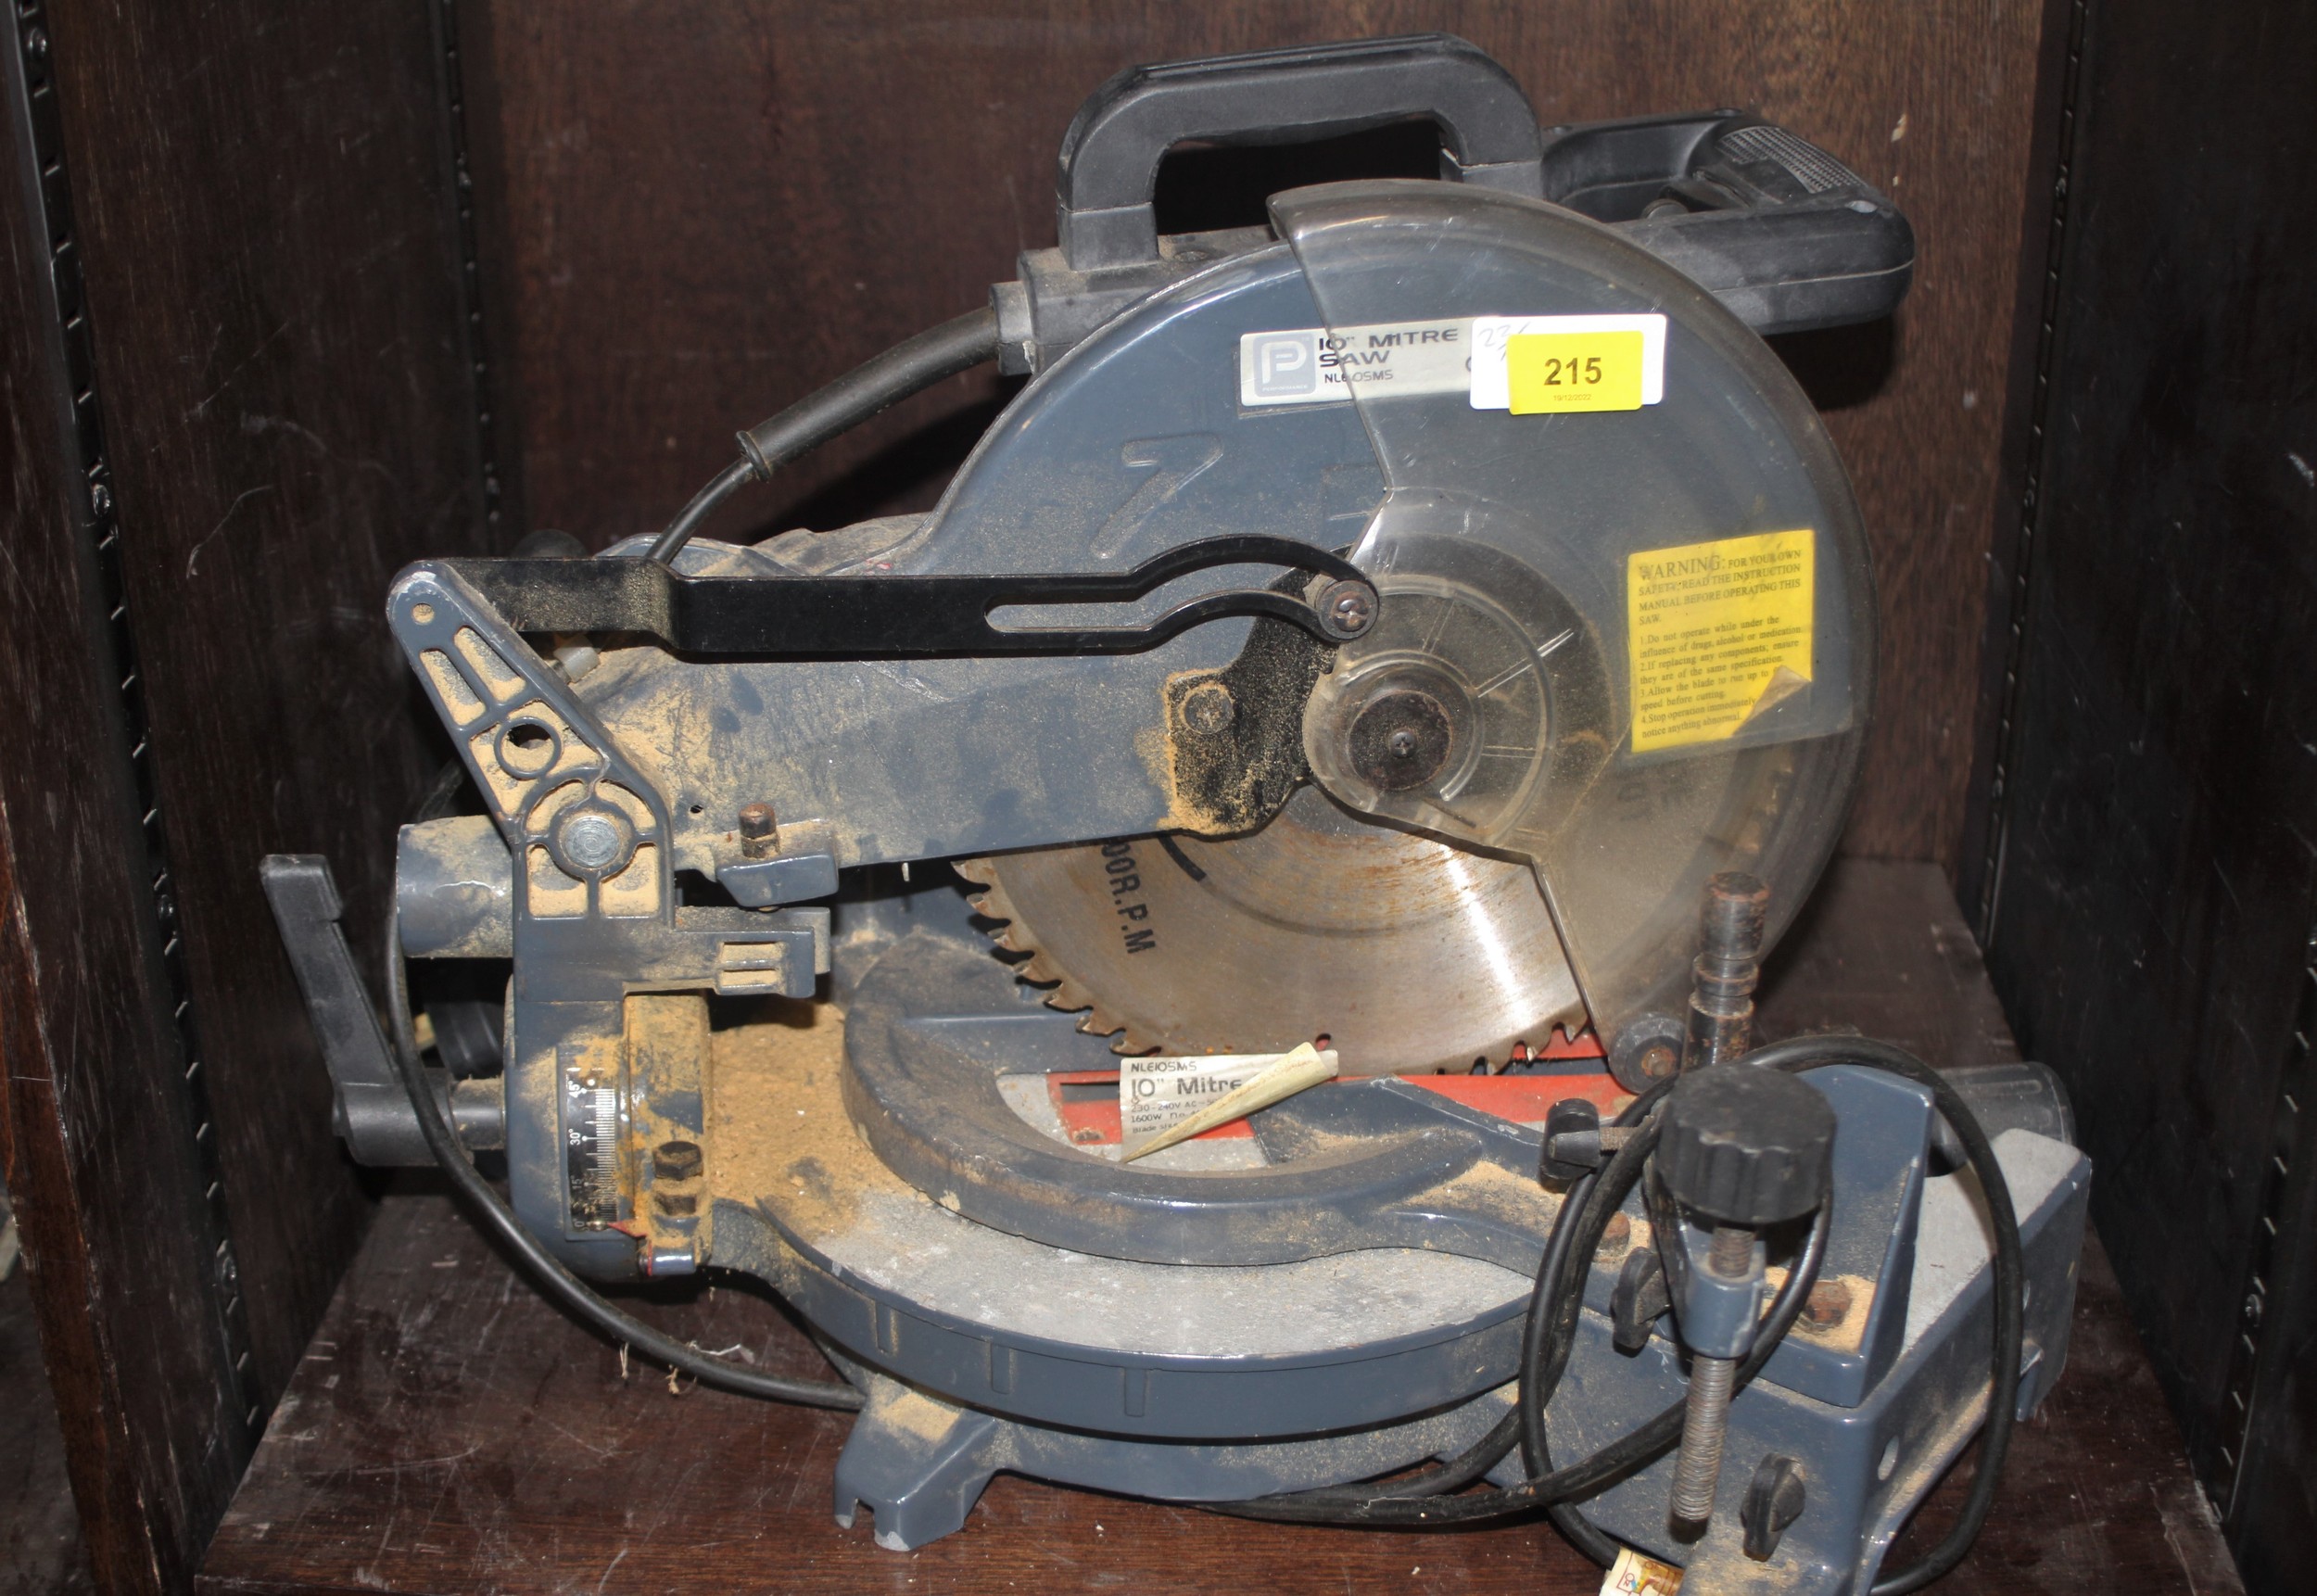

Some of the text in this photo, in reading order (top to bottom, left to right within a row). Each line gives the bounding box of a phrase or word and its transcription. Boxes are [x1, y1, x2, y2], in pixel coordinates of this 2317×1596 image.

[1369, 327, 1459, 348] MITRE
[1319, 349, 1390, 368] SAW
[1543, 356, 1602, 386] 215
[1552, 393, 1592, 402] 19/12/2022
[1639, 550, 1801, 581] WARNING: FOR YOUR OWN
[1682, 577, 1710, 590] READ
[1713, 573, 1731, 584] THE
[1733, 564, 1801, 580] INSTRUCTION
[1639, 578, 1801, 612] MANUAL BEFORE OPERATING THIS
[1639, 613, 1662, 626] SAW.
[1664, 632, 1677, 641] not
[1680, 627, 1711, 640] operate
[1715, 622, 1736, 633] while
[1741, 617, 1763, 629] under
[1767, 615, 1779, 626] the
[1640, 645, 1676, 659] influence
[1678, 642, 1688, 652] of
[1716, 633, 1744, 646] alcohol
[1658, 653, 1696, 669] replacing
[1700, 652, 1715, 663] any
[1772, 640, 1800, 651] ensure
[1640, 676, 1657, 686] they
[1661, 673, 1674, 681] are
[1678, 668, 1687, 678] of
[1690, 665, 1703, 677] the
[1706, 664, 1727, 674] same
[1676, 682, 1690, 692] the
[1692, 678, 1715, 690] blade
[1718, 677, 1727, 685] to
[1730, 675, 1743, 683] run
[1747, 672, 1757, 682] up
[1761, 669, 1769, 678] to
[1640, 701, 1664, 712] speed
[1666, 694, 1692, 706] before
[1668, 705, 1705, 719] operation
[1707, 698, 1757, 713] immediately
[1641, 728, 1666, 739] notice
[1668, 719, 1702, 734] anything
[1177, 1076, 1242, 1095] Mitre
[1131, 1113, 1162, 1123] 1600W
[1133, 1125, 1157, 1134] Blade
